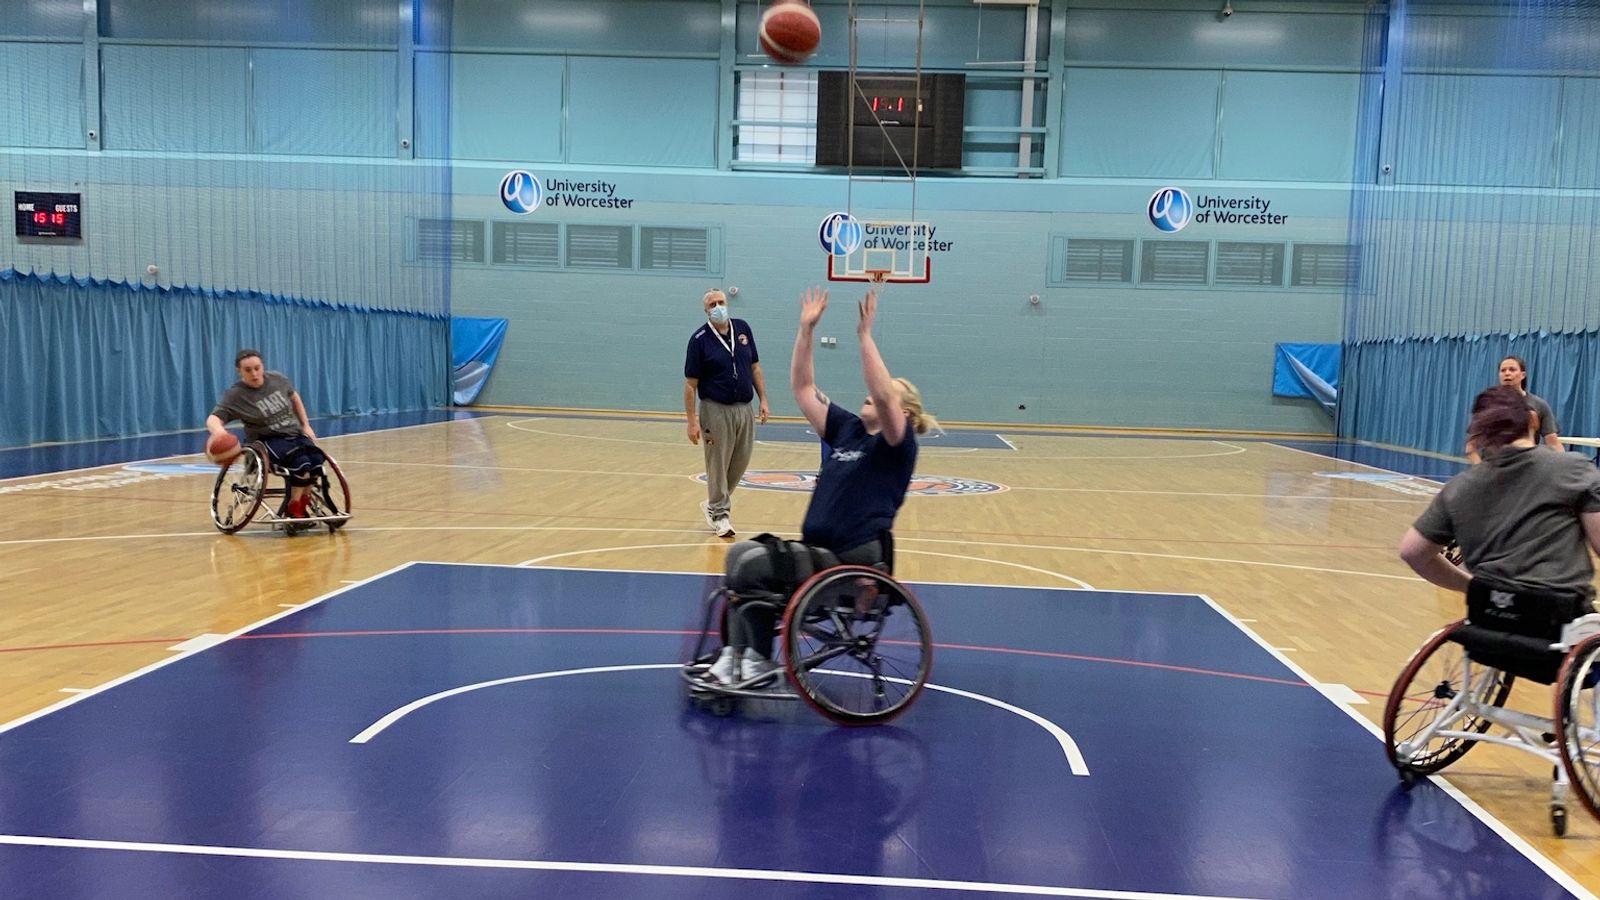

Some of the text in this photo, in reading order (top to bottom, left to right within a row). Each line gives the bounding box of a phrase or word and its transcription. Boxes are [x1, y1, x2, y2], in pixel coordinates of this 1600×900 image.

[546, 179, 616, 197] University
[18, 203, 78, 212] HOME GUESTS
[546, 193, 634, 209] of Worcester
[1197, 195, 1270, 213] University
[34, 212, 64, 224] 15 15
[1195, 210, 1288, 225] of Worcester
[866, 223, 936, 240] University
[864, 236, 954, 252] of Worcester
